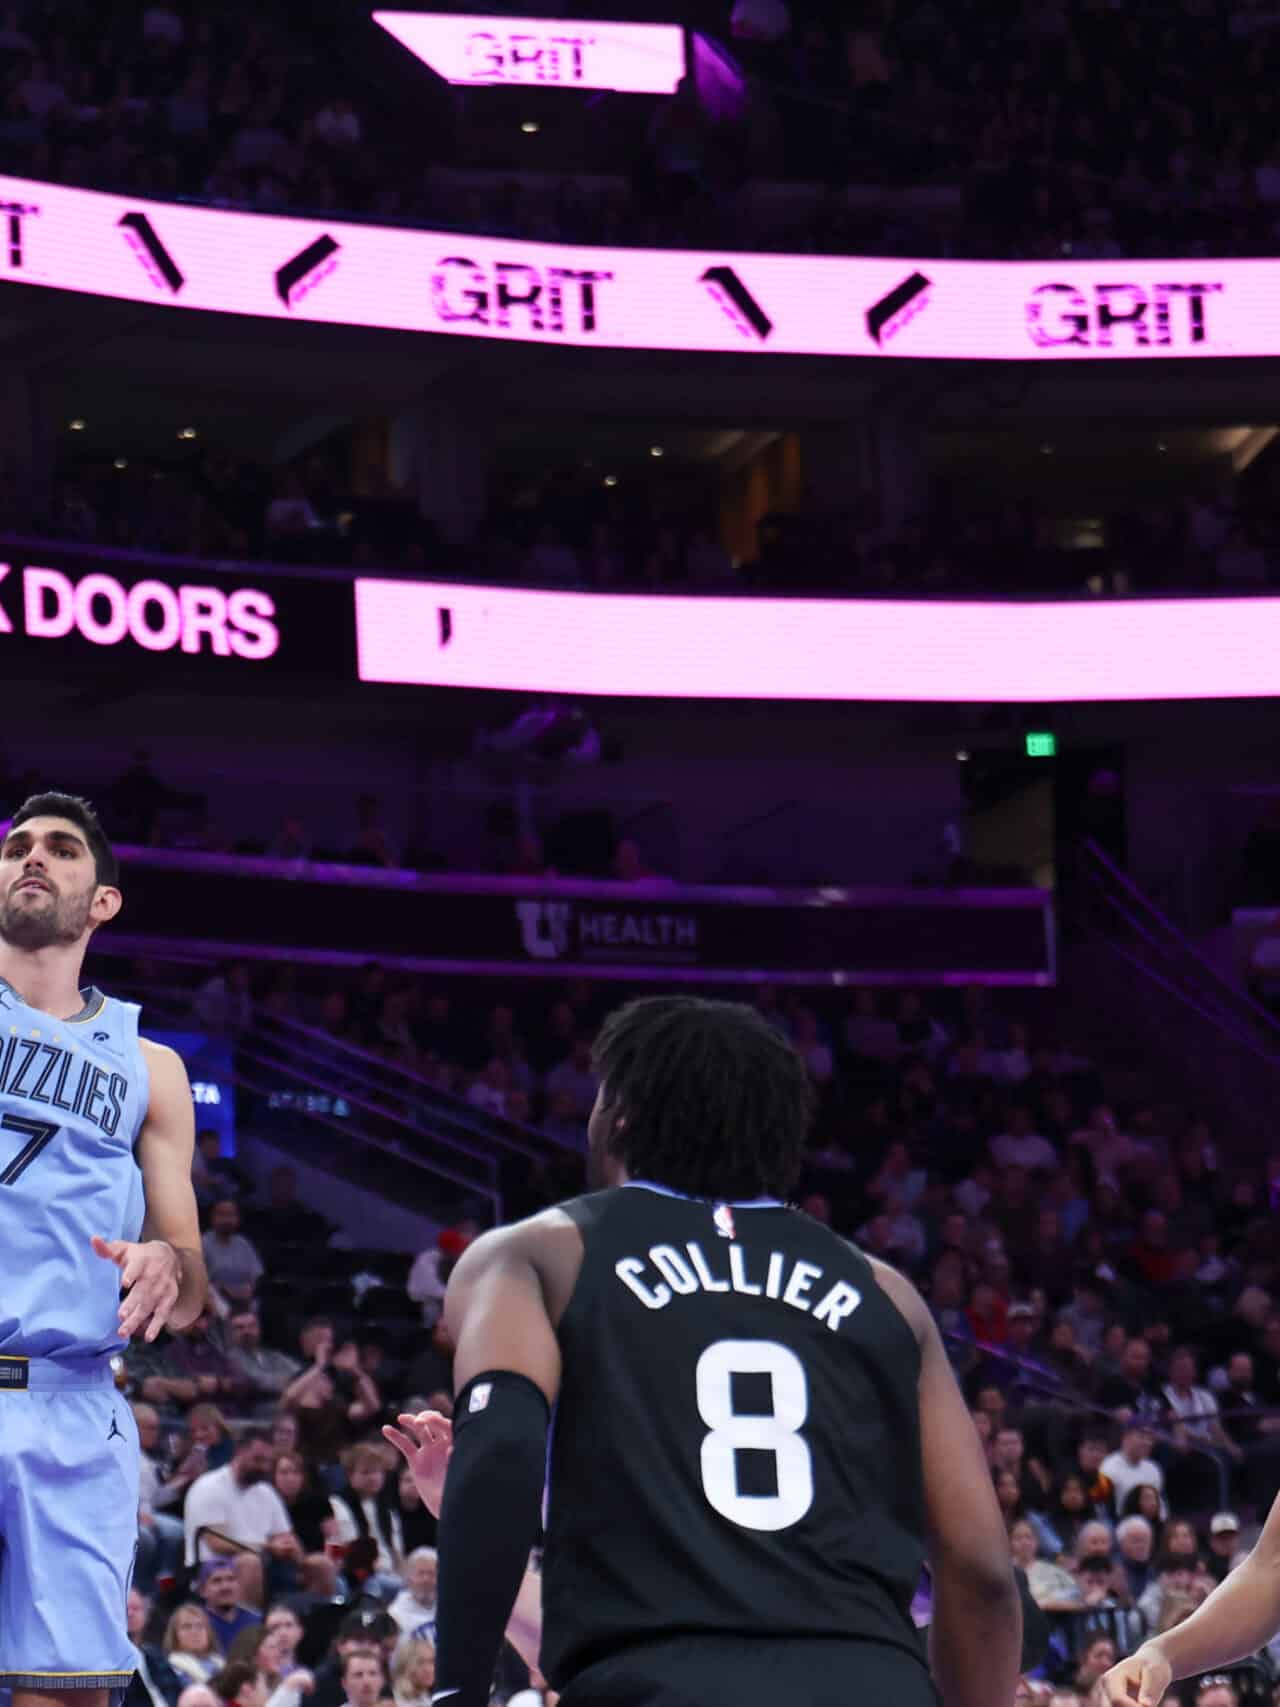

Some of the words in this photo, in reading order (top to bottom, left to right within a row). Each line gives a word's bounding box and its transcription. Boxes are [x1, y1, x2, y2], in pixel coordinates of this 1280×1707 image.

[464, 32, 595, 81] GRIT
[431, 256, 614, 333] GRIT
[1024, 281, 1224, 348] GRIT
[22, 565, 280, 660] DOORS
[578, 912, 698, 945] HEALTH
[614, 1242, 862, 1333] COLLIER
[694, 1338, 815, 1532] 8
